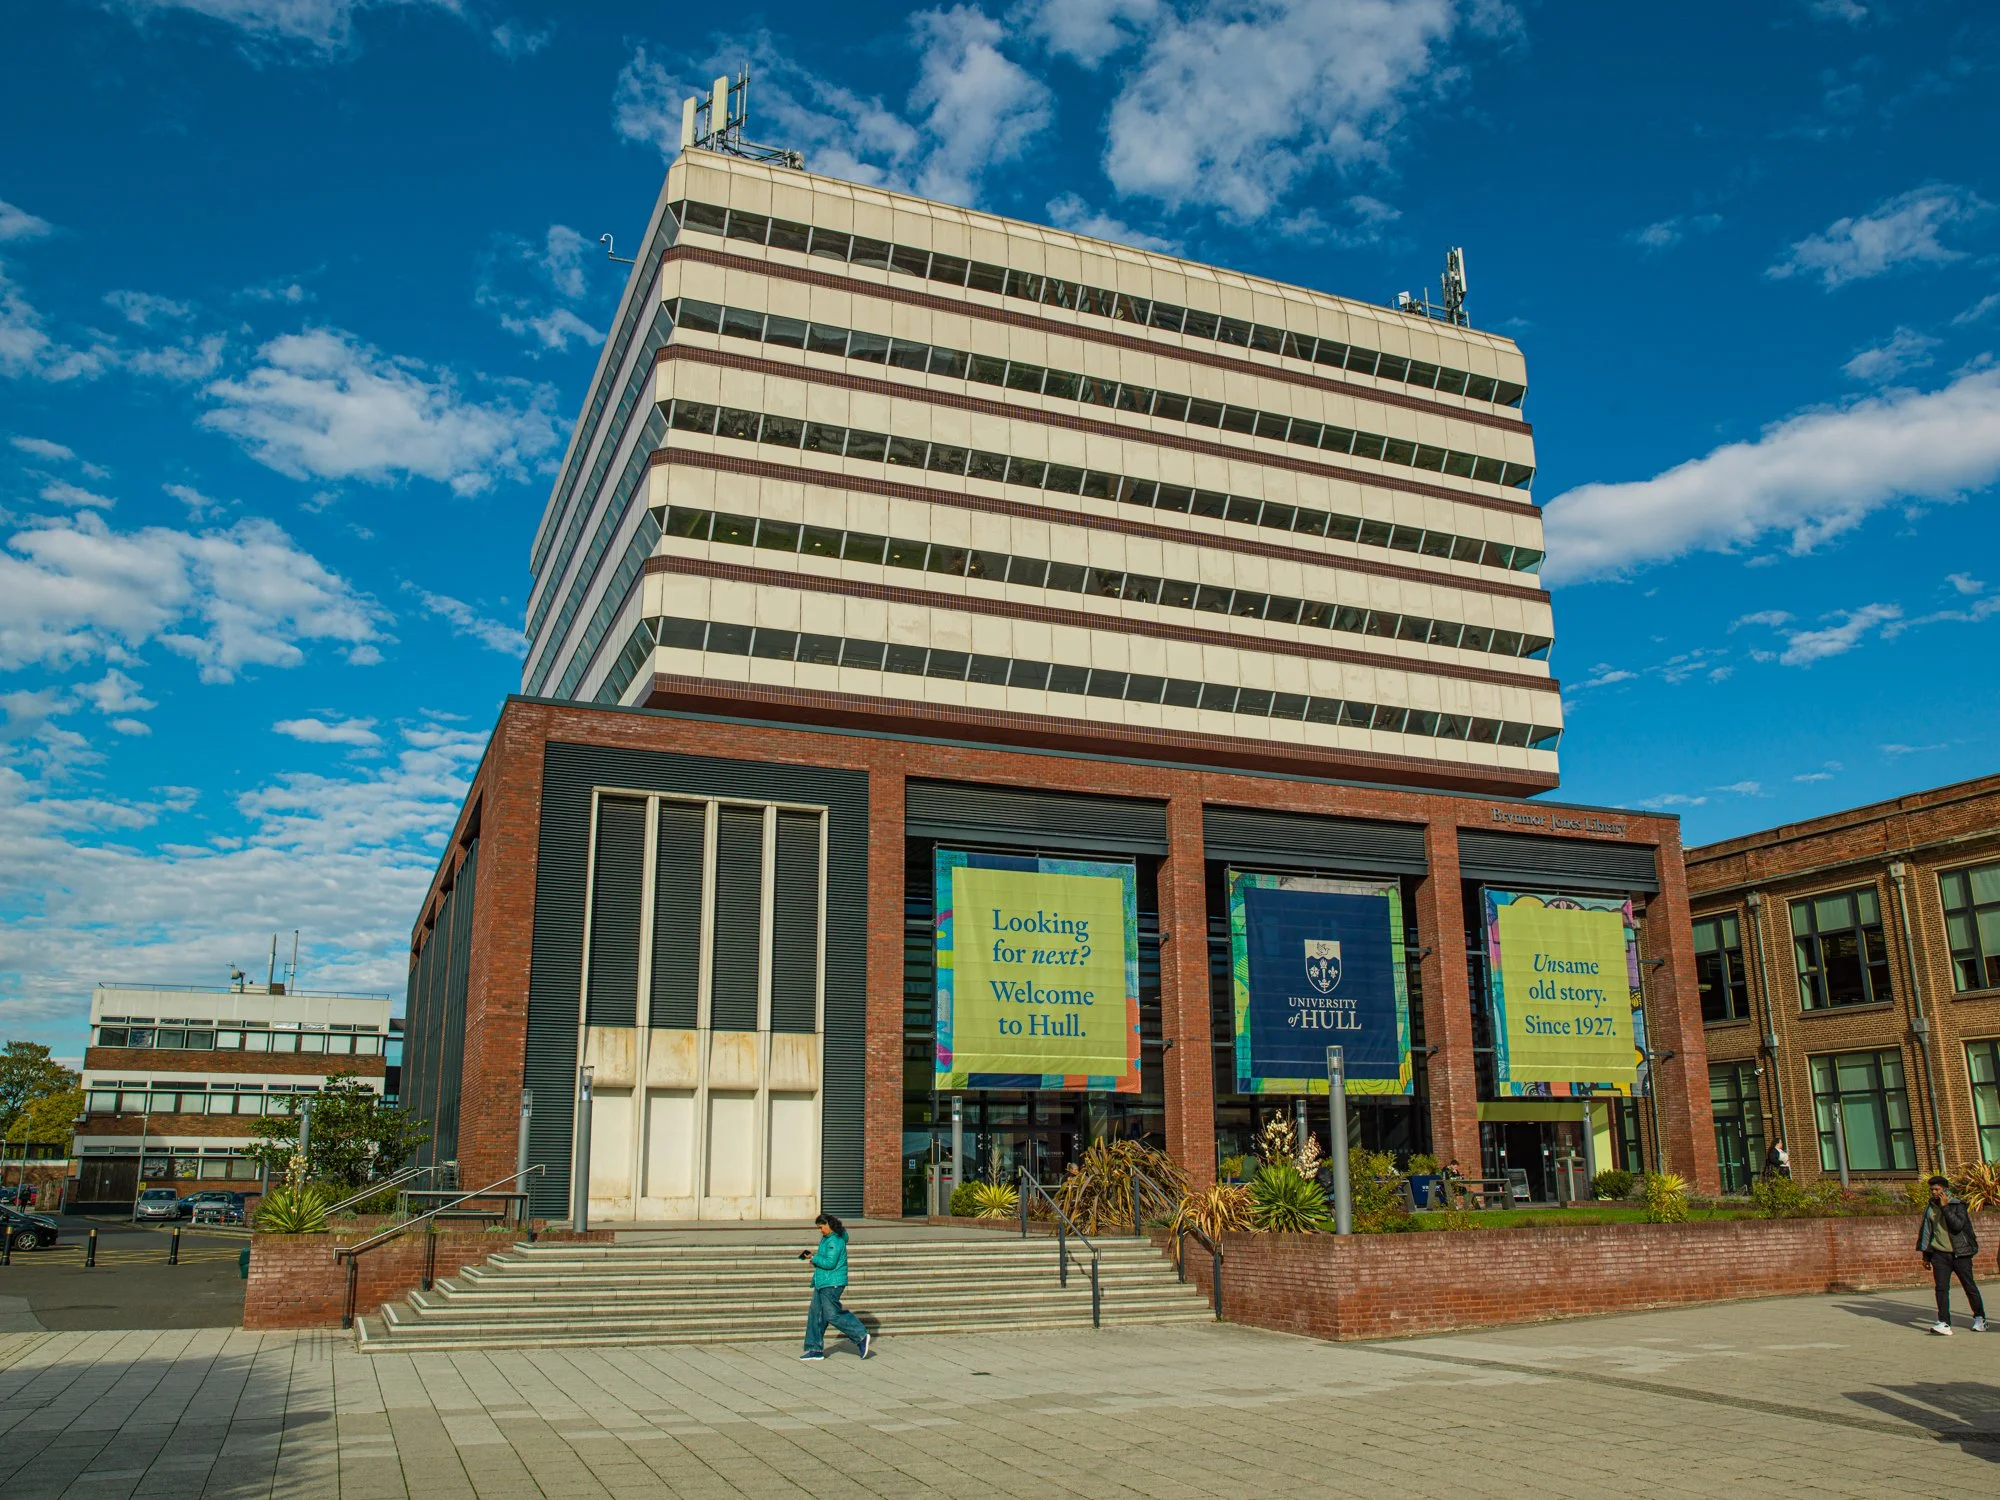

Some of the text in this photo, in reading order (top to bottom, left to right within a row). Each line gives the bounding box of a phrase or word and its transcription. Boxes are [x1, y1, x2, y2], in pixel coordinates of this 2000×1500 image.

[1491, 808, 1627, 838] Brynmor Jones Library
[992, 909, 1089, 943] Looking
[992, 938, 1092, 966] for next?
[1533, 953, 1599, 975] Unsame
[989, 980, 1095, 1006] Welcome
[1288, 997, 1358, 1009] UNIVERSITY
[1529, 980, 1608, 1009] old story.
[998, 1013, 1087, 1037] to Hull.
[1287, 1009, 1363, 1030] of HULL
[1525, 1014, 1617, 1037] Since 1927.
